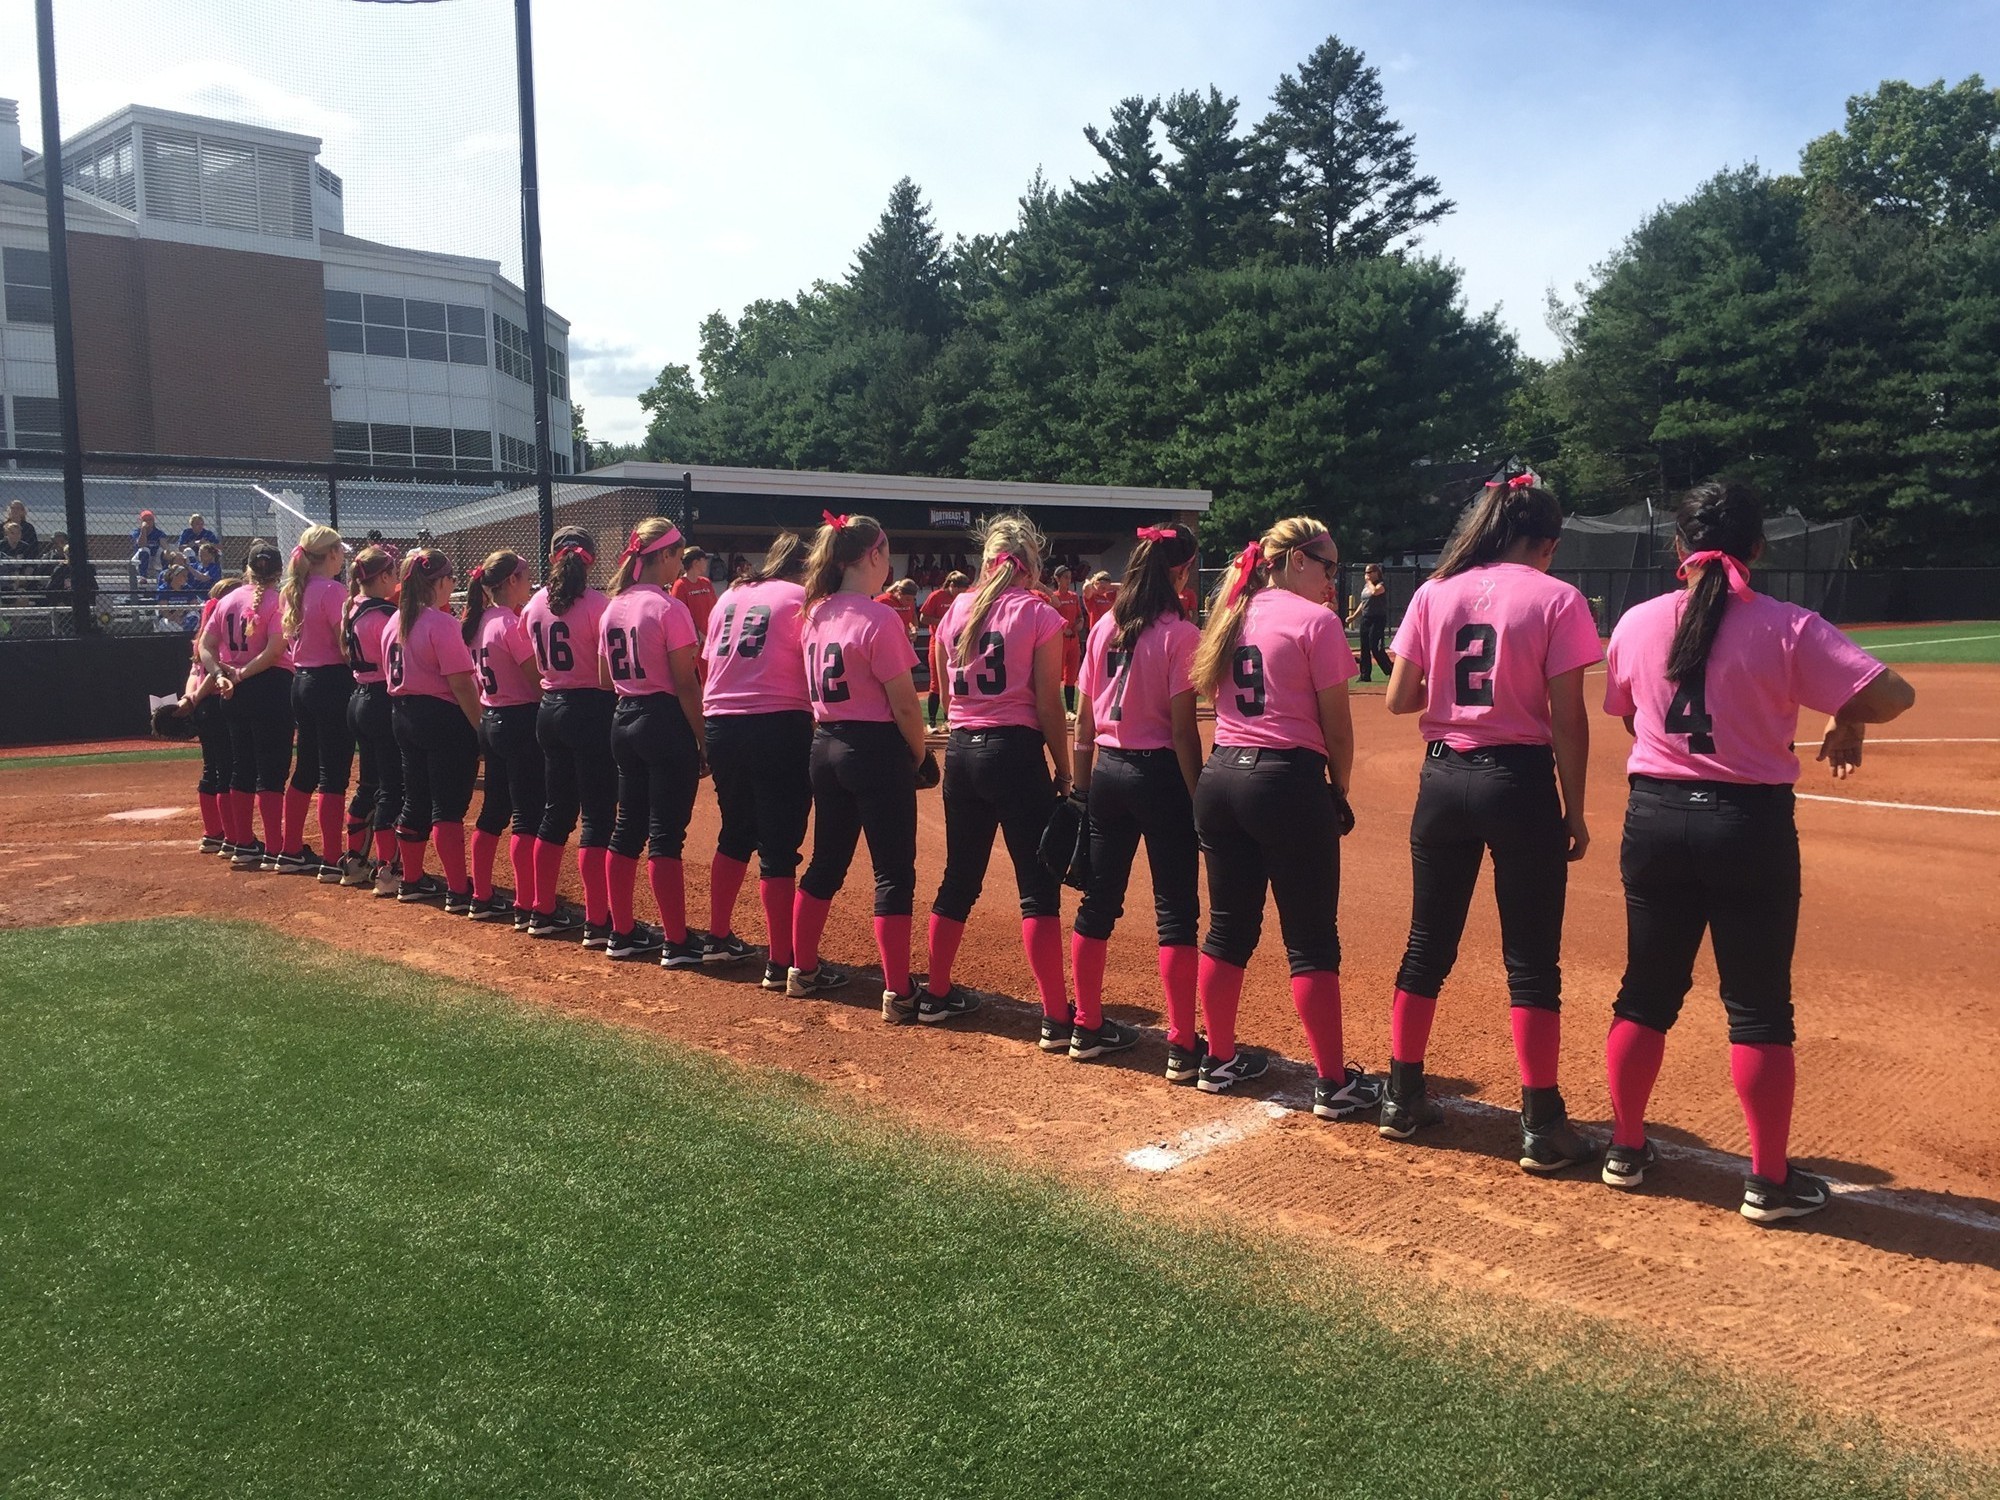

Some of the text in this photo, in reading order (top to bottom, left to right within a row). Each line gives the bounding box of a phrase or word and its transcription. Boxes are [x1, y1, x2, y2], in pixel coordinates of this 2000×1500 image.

[227, 613, 248, 652] 11
[533, 621, 574, 671] 16
[607, 627, 646, 680] 21
[717, 604, 771, 658] 18
[808, 643, 850, 703] 12
[1107, 651, 1133, 721] 7
[1233, 645, 1266, 717] 9
[1455, 624, 1497, 706] 2
[1665, 668, 1716, 754] 4
[1607, 1158, 1631, 1173] NIKE
